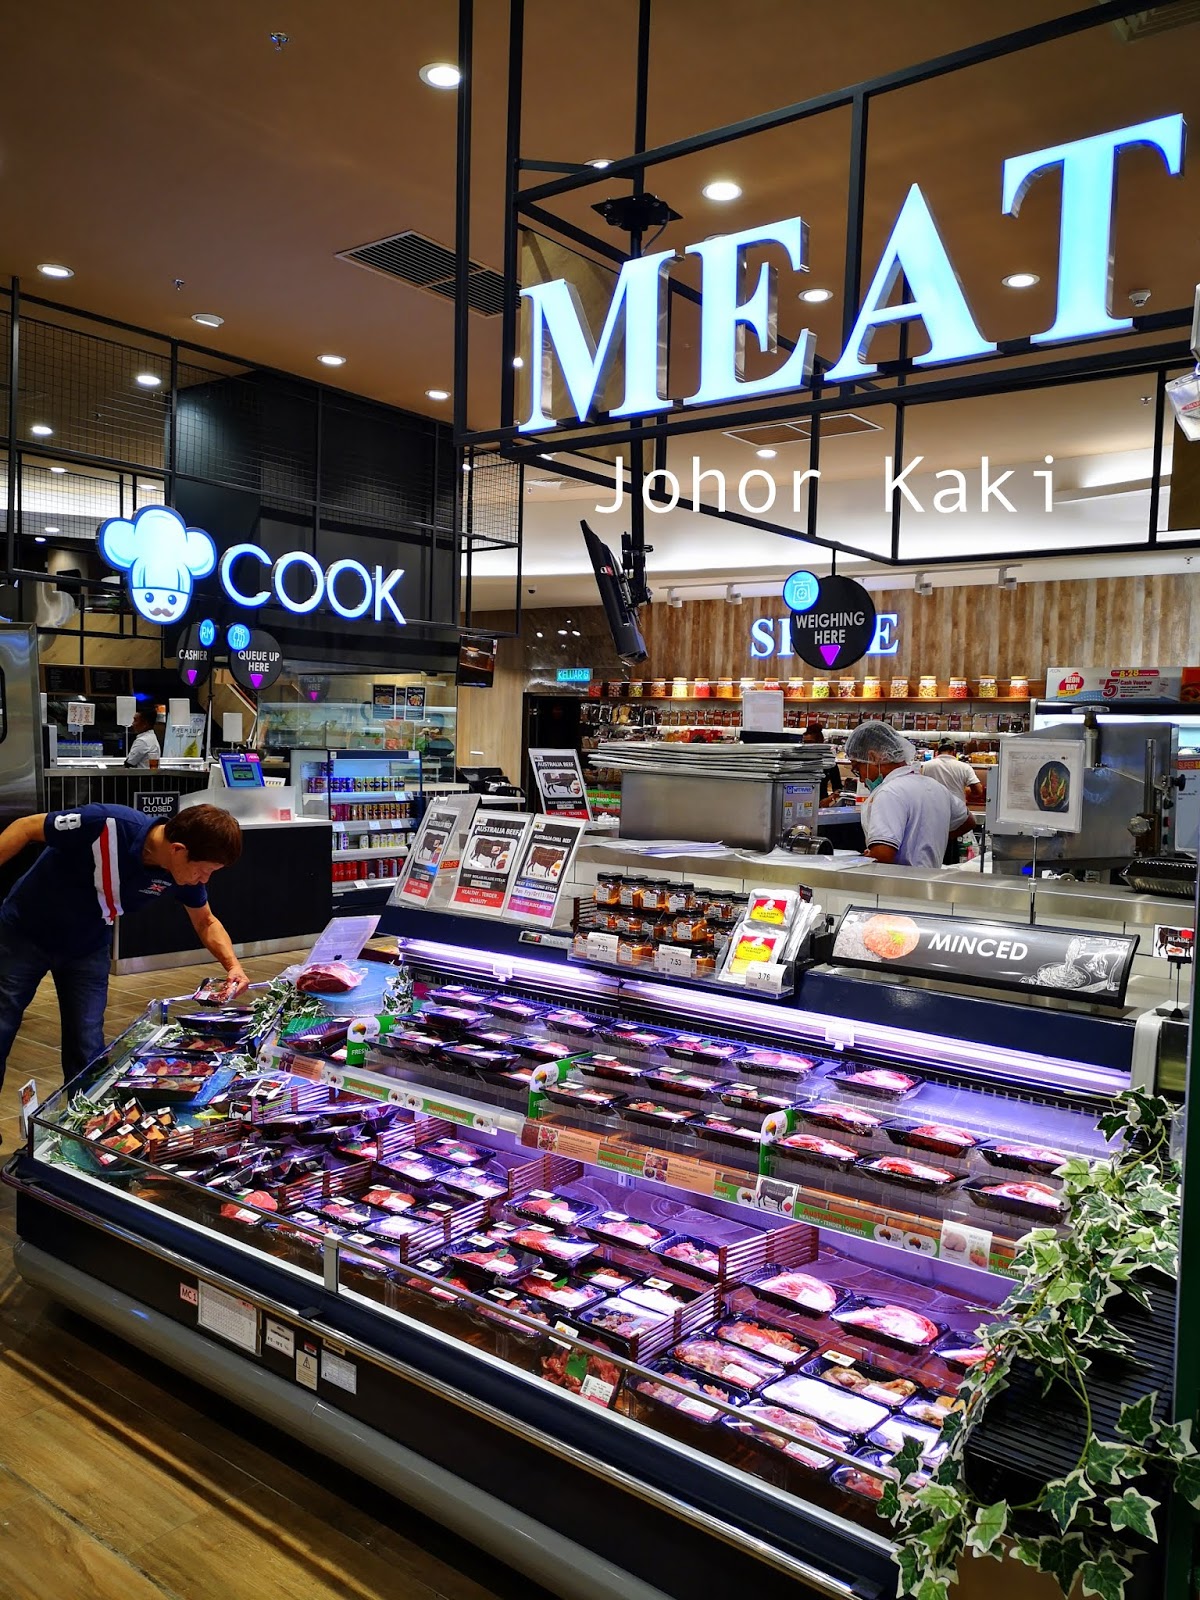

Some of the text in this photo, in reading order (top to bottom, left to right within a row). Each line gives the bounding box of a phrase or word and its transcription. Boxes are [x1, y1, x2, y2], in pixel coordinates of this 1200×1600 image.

[518, 113, 1185, 432] MEAT
[219, 543, 407, 625] COOK
[796, 611, 865, 628] WEIGHING
[202, 627, 212, 640] RM
[814, 629, 846, 644] HERE
[179, 649, 207, 661] CASHIER
[238, 650, 280, 662] QUEUE UP
[248, 662, 269, 672] HERE
[142, 797, 173, 805] TUTUP
[476, 826, 506, 835] AUSTRALIA
[928, 932, 1028, 961] MINCED
[758, 973, 770, 981] 3.76
[803, 1208, 862, 1229] Australian Beef
[823, 1220, 842, 1229] TENDER
[845, 1226, 866, 1236] QUALITY
[182, 1288, 197, 1302] MC 1
